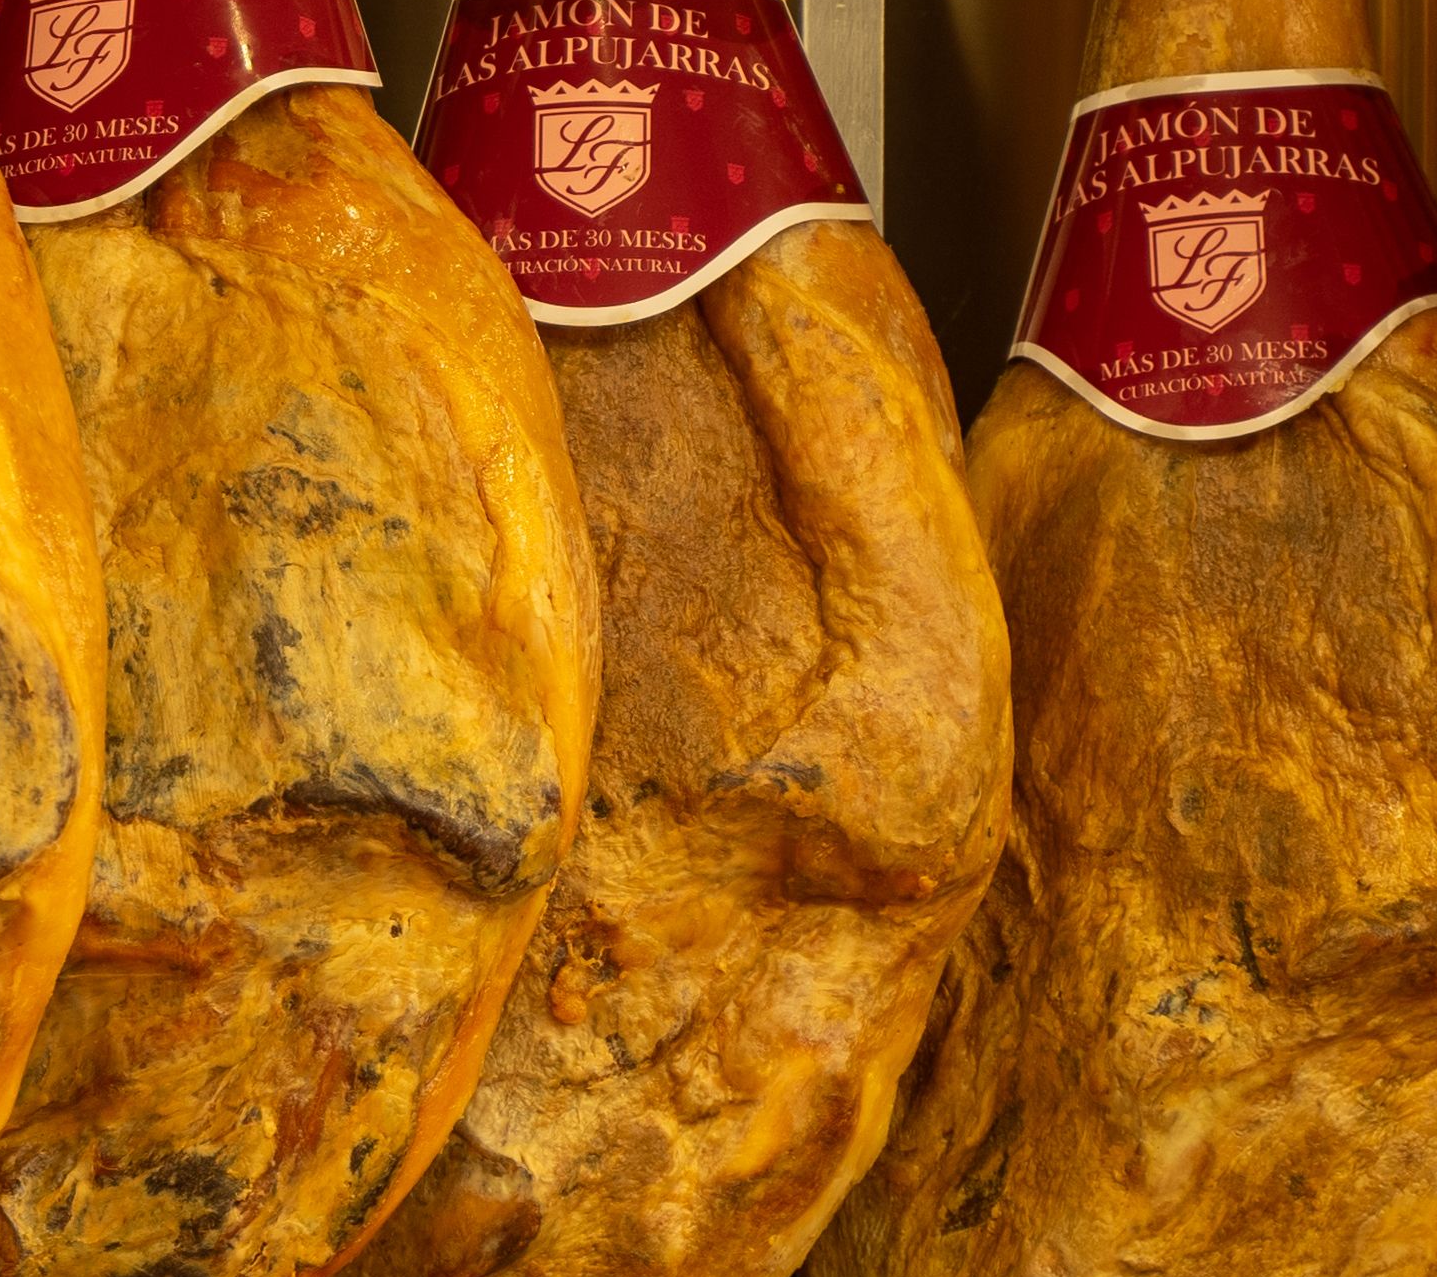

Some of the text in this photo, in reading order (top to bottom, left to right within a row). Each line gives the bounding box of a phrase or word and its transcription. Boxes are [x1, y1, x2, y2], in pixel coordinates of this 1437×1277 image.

[641, 2, 710, 40] DE
[433, 35, 772, 102] LAS ALPUJARRAS
[22, 127, 57, 151] DE
[62, 123, 88, 143] 30
[94, 115, 180, 139] MESES
[1094, 101, 1318, 167] JAMÓN DE
[1, 145, 158, 179] RACIÓN NATURAL
[1054, 144, 1381, 224] LAS ALPUJARRAS
[539, 228, 579, 250] DE
[584, 227, 612, 248] 30
[619, 228, 707, 253] MESES
[594, 257, 688, 275] NATURAL
[1100, 339, 1329, 382] MÁS DE 30 MESES
[1118, 373, 1216, 402] CURACIÓN
